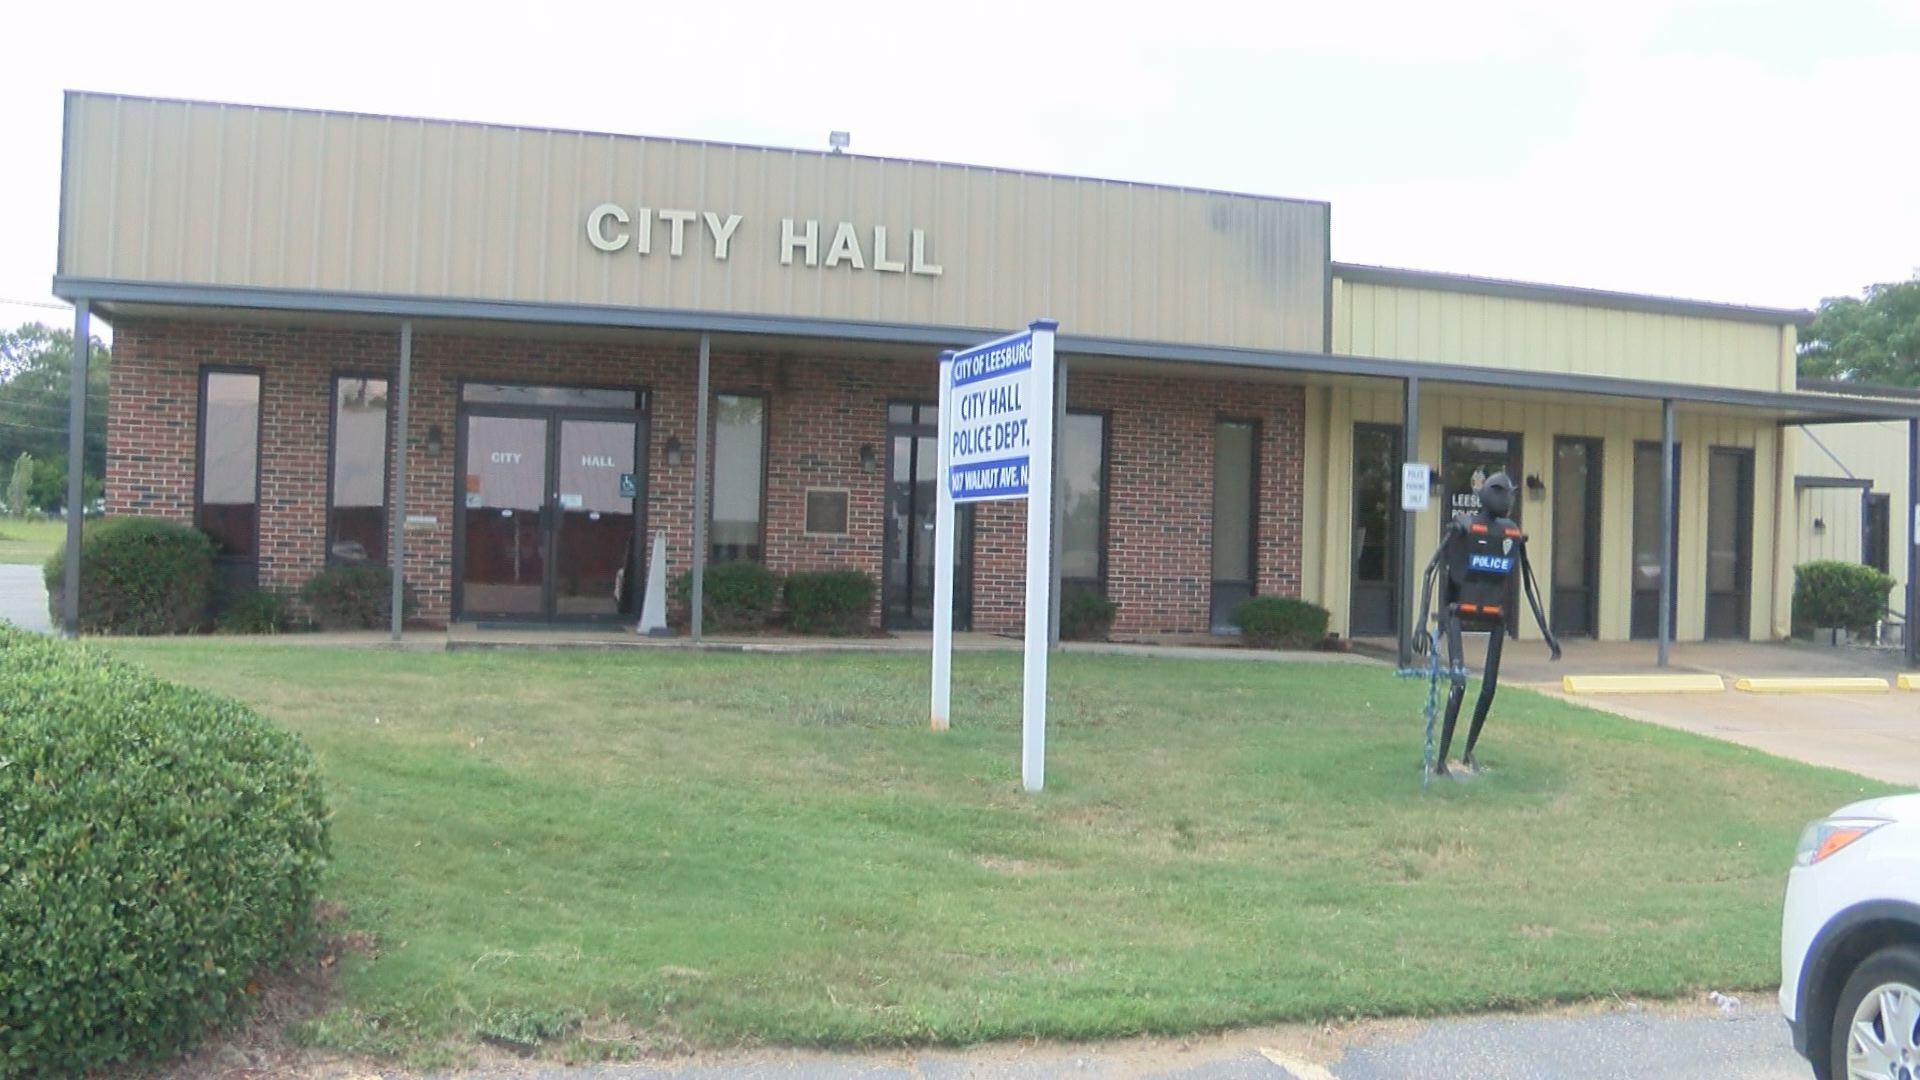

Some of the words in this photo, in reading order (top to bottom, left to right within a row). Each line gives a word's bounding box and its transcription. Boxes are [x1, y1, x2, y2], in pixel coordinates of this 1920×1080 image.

[586, 202, 744, 260] CITY
[779, 217, 944, 276] HALL
[954, 357, 973, 381] CITY
[972, 353, 985, 376] OF
[985, 340, 1032, 373] LEESBURG
[961, 391, 987, 421] CITY
[989, 383, 1022, 416] HALL
[953, 425, 992, 457] POLICE
[995, 418, 1031, 451] DEPT.
[491, 451, 522, 464] CITY
[582, 455, 615, 468] HALL
[965, 467, 999, 491] WALNUT
[1472, 554, 1510, 570] POLICE
